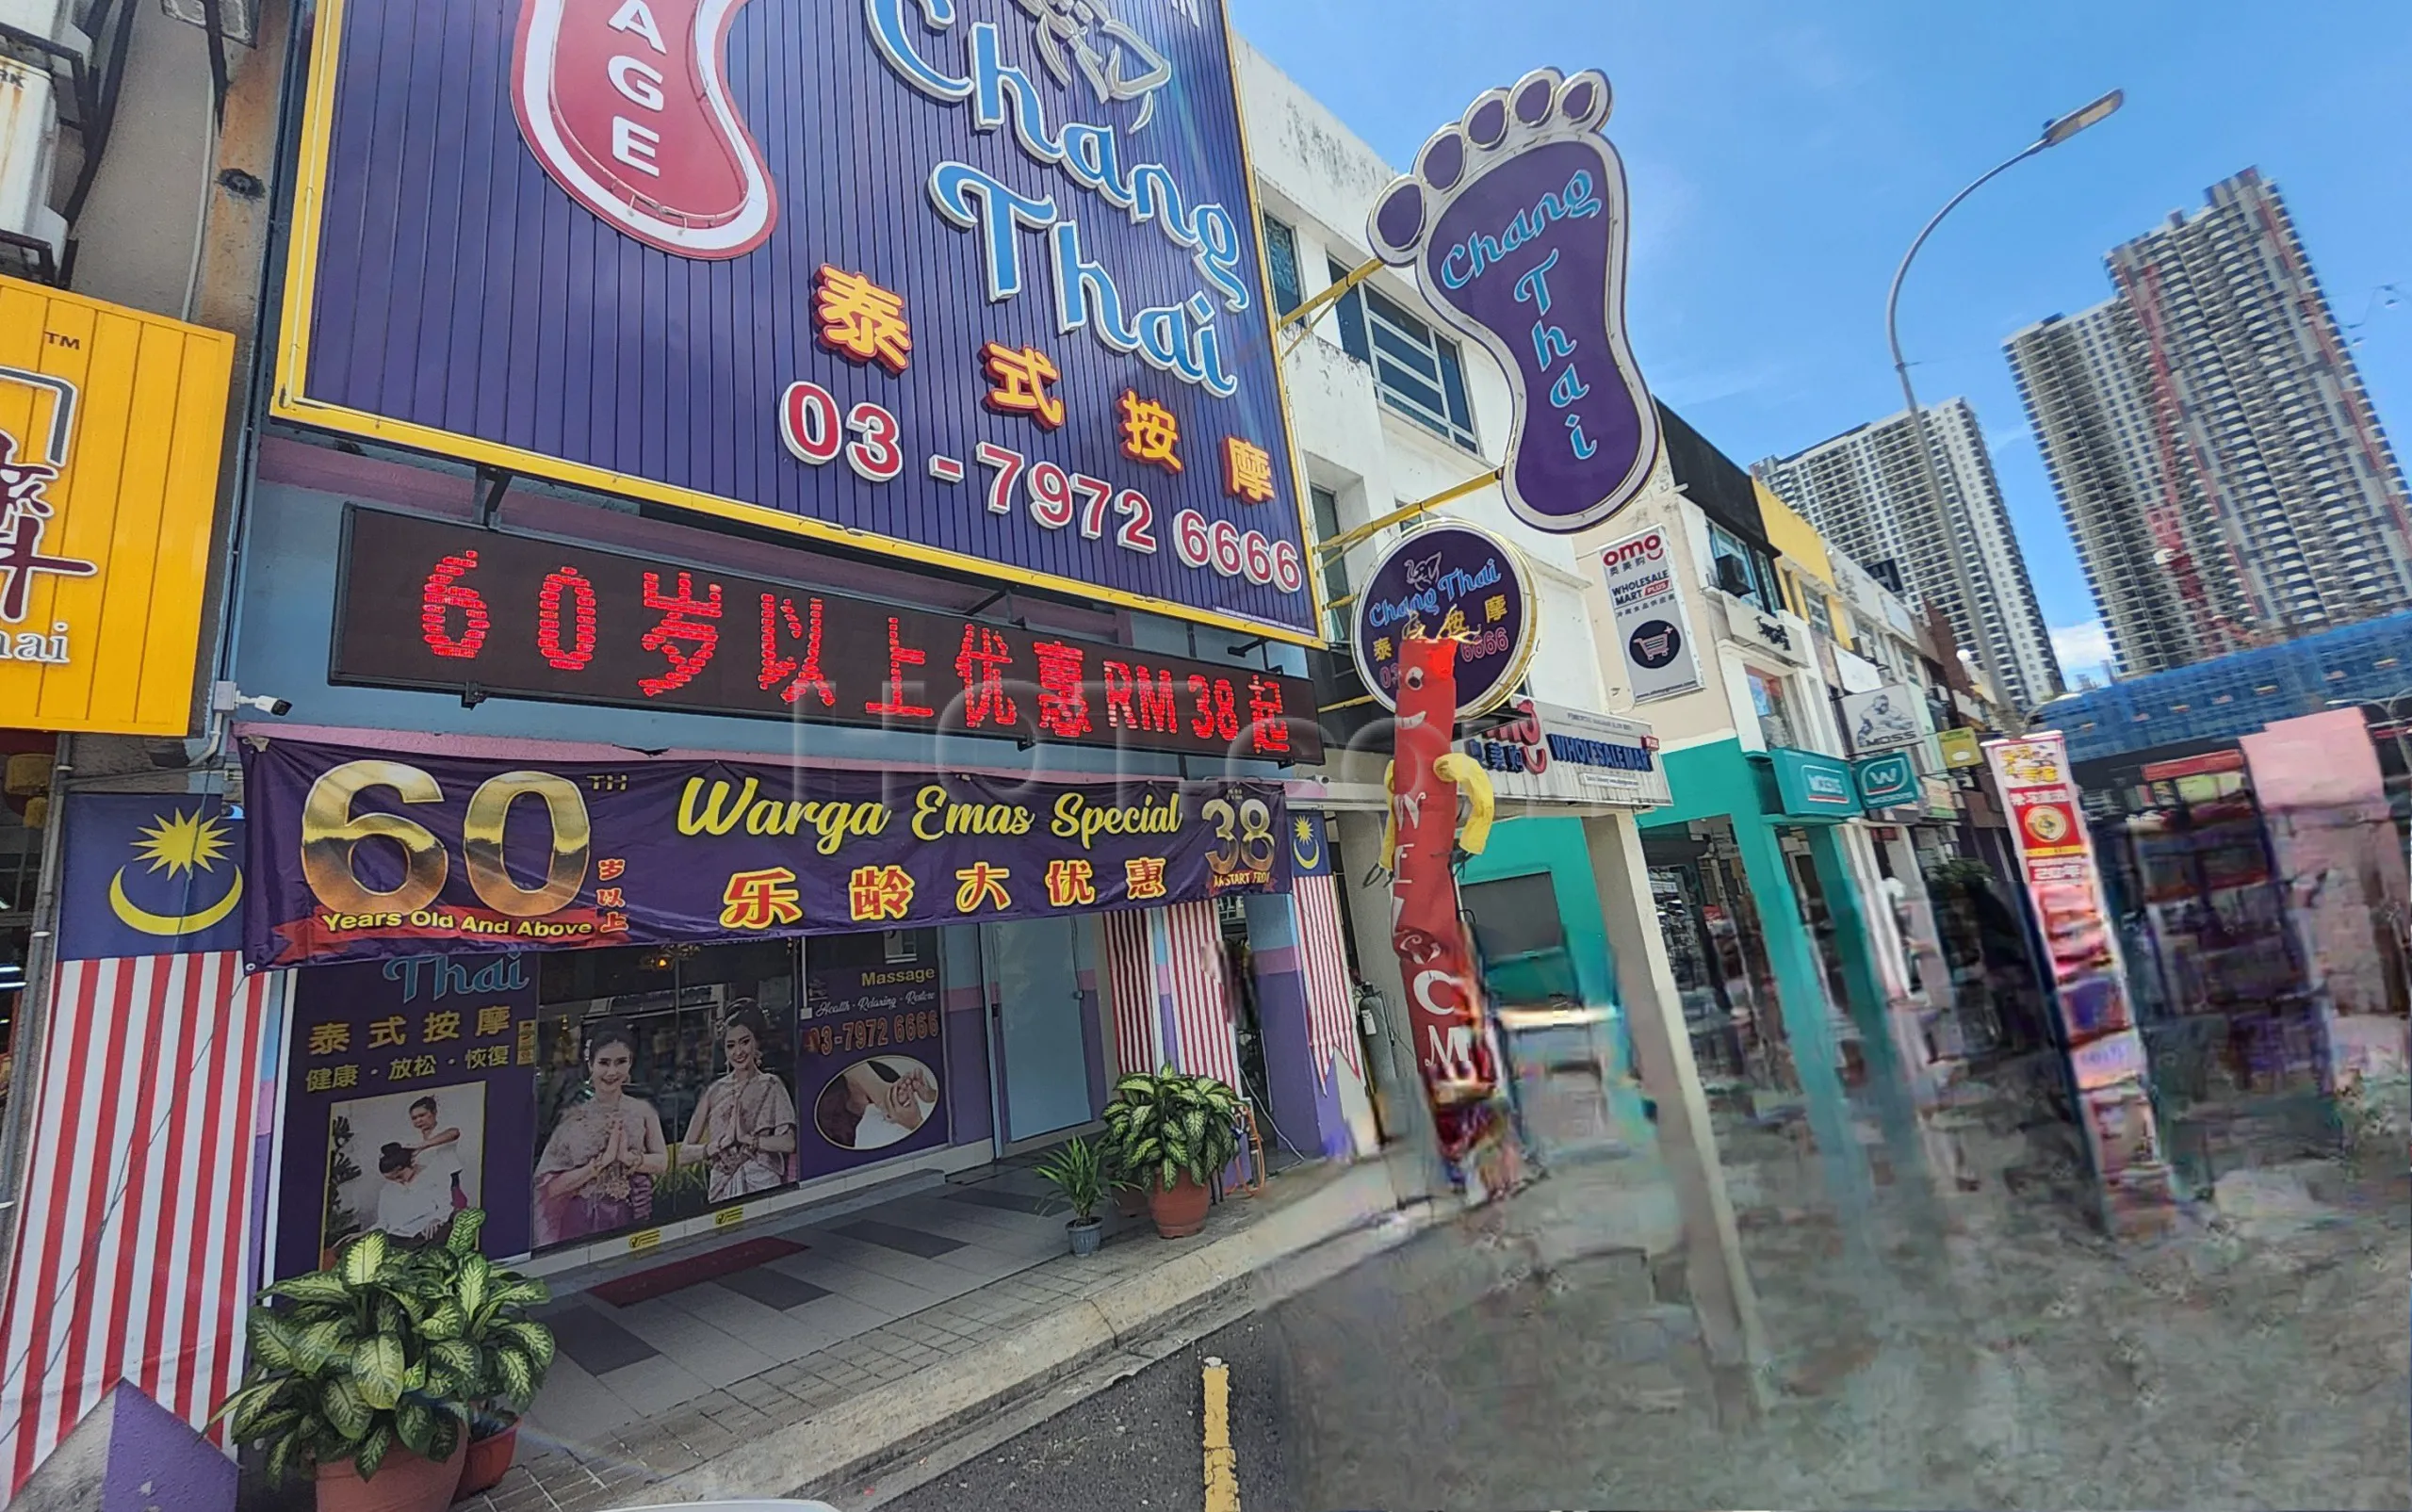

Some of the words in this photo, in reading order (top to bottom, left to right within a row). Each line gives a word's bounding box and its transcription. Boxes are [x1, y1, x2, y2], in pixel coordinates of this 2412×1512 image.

[864, 0, 1250, 313] Chang
[1442, 170, 1602, 289] Chang
[927, 160, 1238, 398] Thai
[45, 332, 81, 350] TM
[1514, 249, 1597, 460] Thai
[813, 263, 1278, 504] 泰式按摩
[1173, 509, 1302, 593] 6666
[1603, 535, 1662, 566] omo
[1369, 587, 1441, 627] Chang
[1437, 558, 1502, 601] Thai
[1612, 569, 1670, 596] WHOLESALE
[1615, 589, 1642, 606] MART
[1545, 734, 1625, 768] WHOLESALE
[677, 776, 891, 854] Warga
[911, 785, 1035, 841] Emas
[1050, 792, 1183, 850] Special
[1201, 798, 1276, 875] 38
[321, 910, 402, 932] Years
[410, 909, 454, 929] Old
[461, 916, 510, 935] And
[516, 920, 593, 937] Above
[383, 951, 530, 1004] Thai
[861, 967, 936, 986] Massage
[308, 1005, 512, 1056] 泰式按摩
[816, 1000, 850, 1017] Health
[857, 994, 897, 1011] Relaxing
[894, 1010, 939, 1043] 6666
